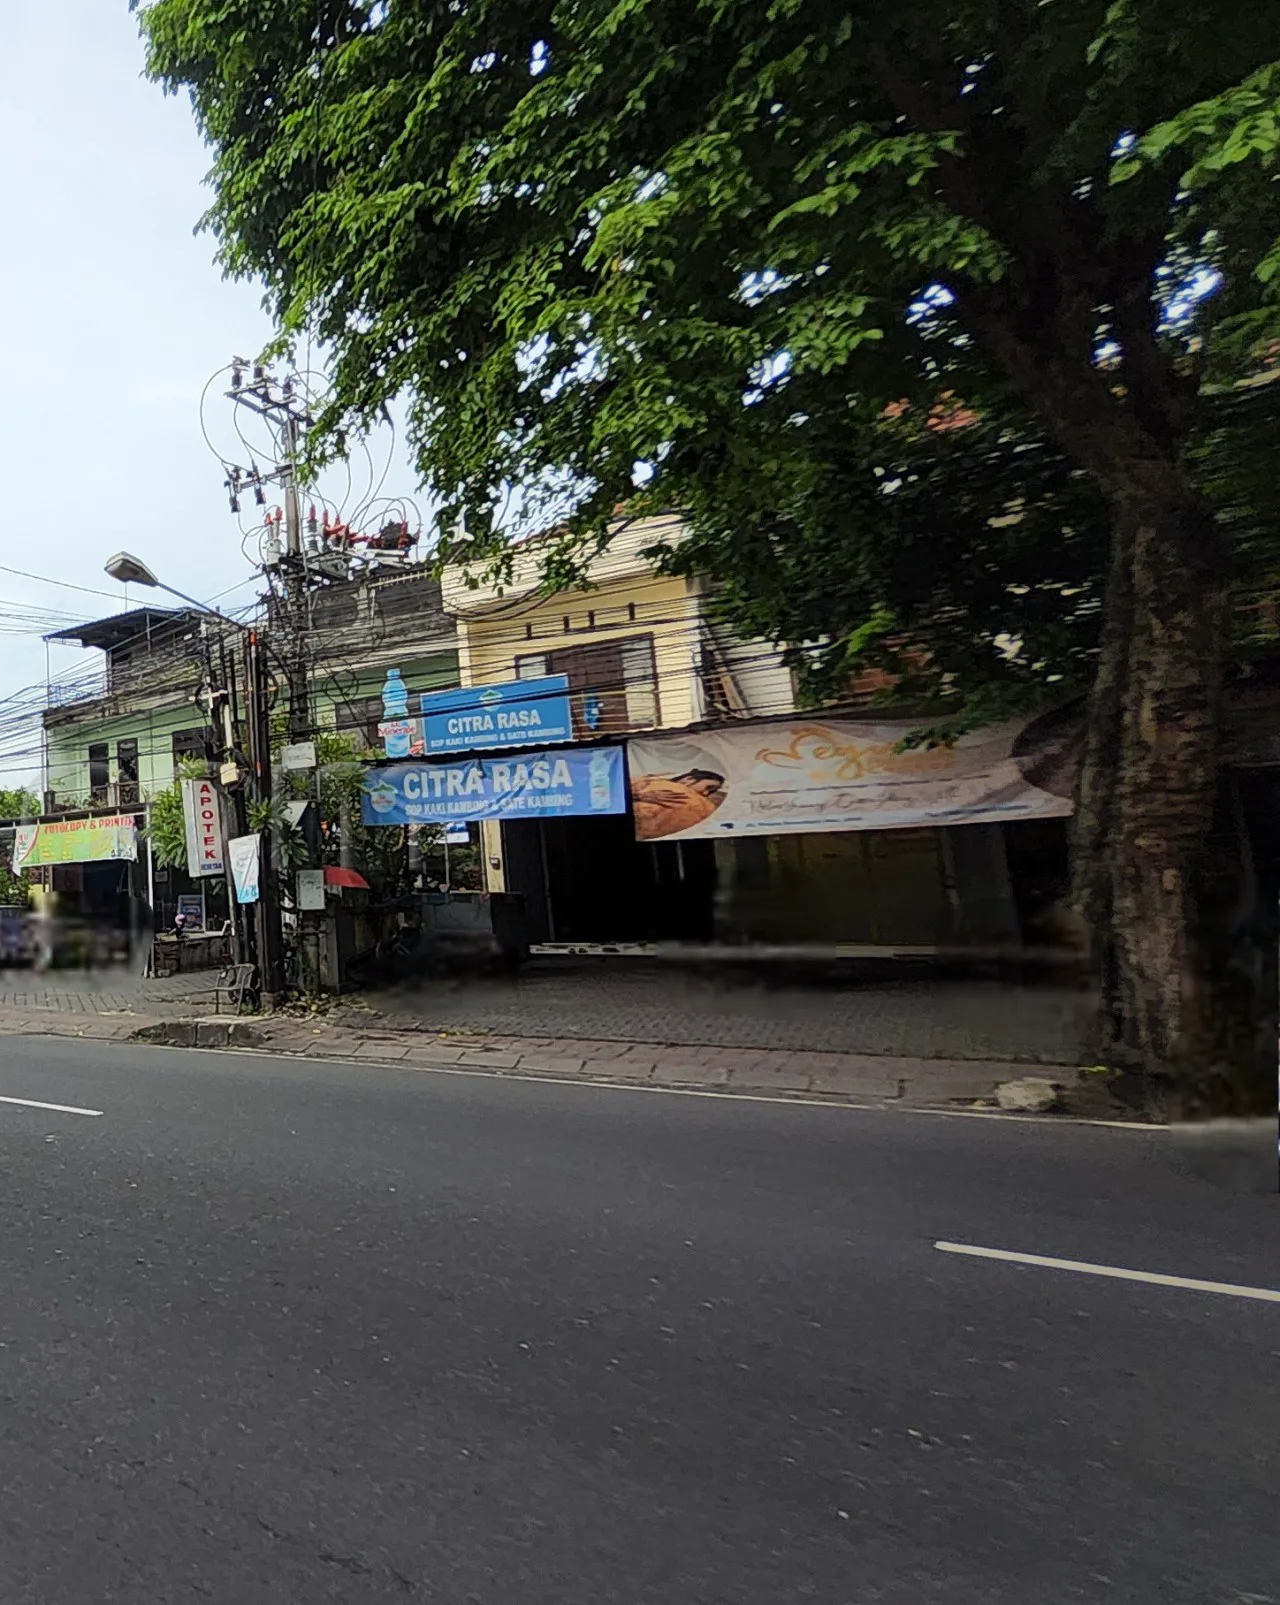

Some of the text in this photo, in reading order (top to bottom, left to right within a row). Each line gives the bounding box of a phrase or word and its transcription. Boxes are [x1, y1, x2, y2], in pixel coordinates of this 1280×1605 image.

[448, 708, 542, 734] CITRA RASA
[403, 759, 573, 800] CITRA RASA
[405, 803, 423, 816] SOP
[424, 801, 446, 815] KAKI
[501, 796, 525, 811] SATE
[89, 821, 97, 830] &
[200, 784, 217, 859] APOTEK
